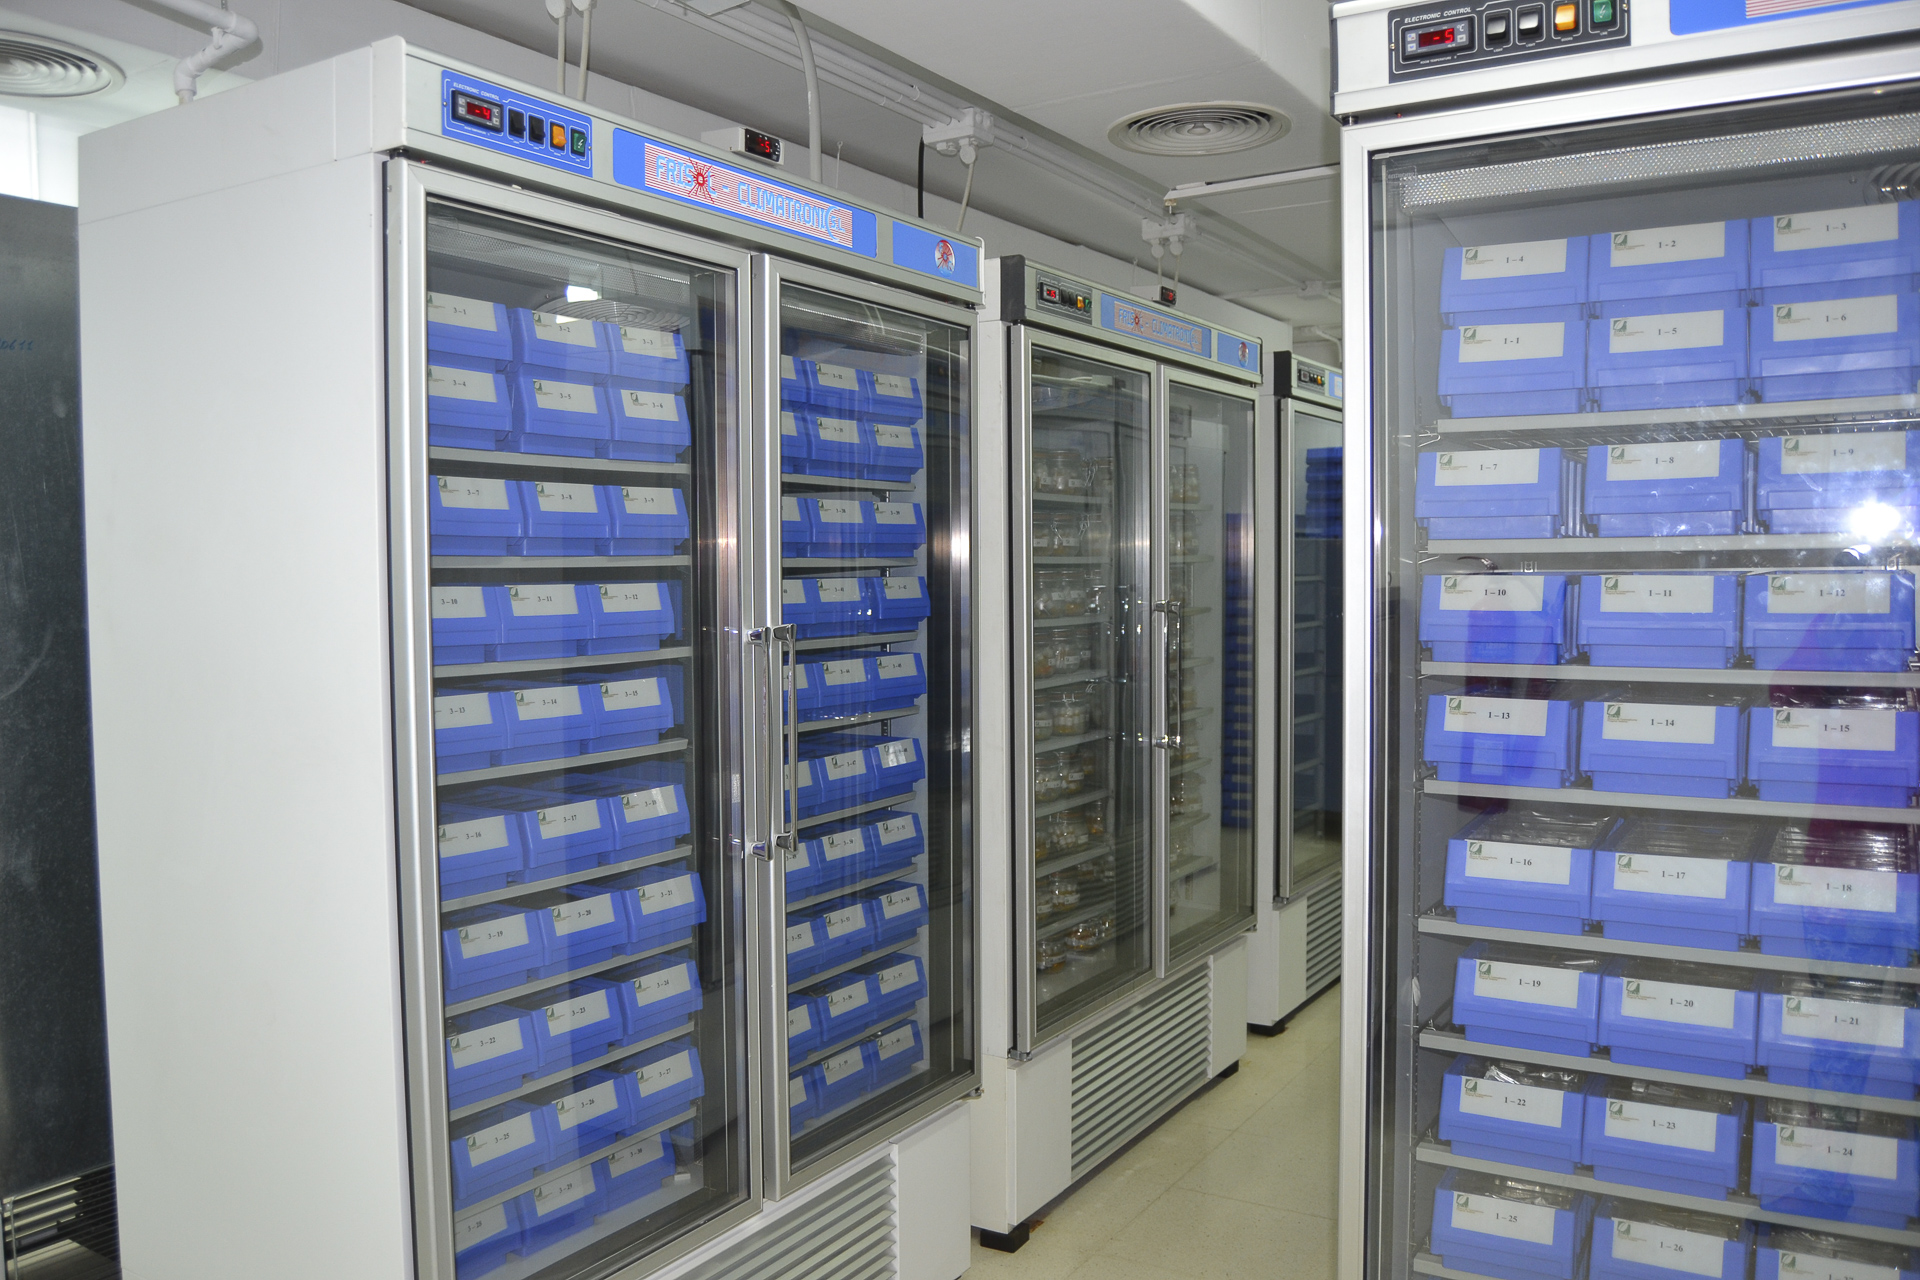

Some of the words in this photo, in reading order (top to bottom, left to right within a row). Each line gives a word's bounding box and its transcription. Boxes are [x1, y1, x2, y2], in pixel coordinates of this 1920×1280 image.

[1404, 12, 1442, 24] ELECTRONIC
[1443, 7, 1472, 17] CONTROL
[453, 82, 479, 95] ELECTRONIC
[481, 90, 500, 101] CONTROL
[737, 181, 840, 241] CLIMATRONIC
